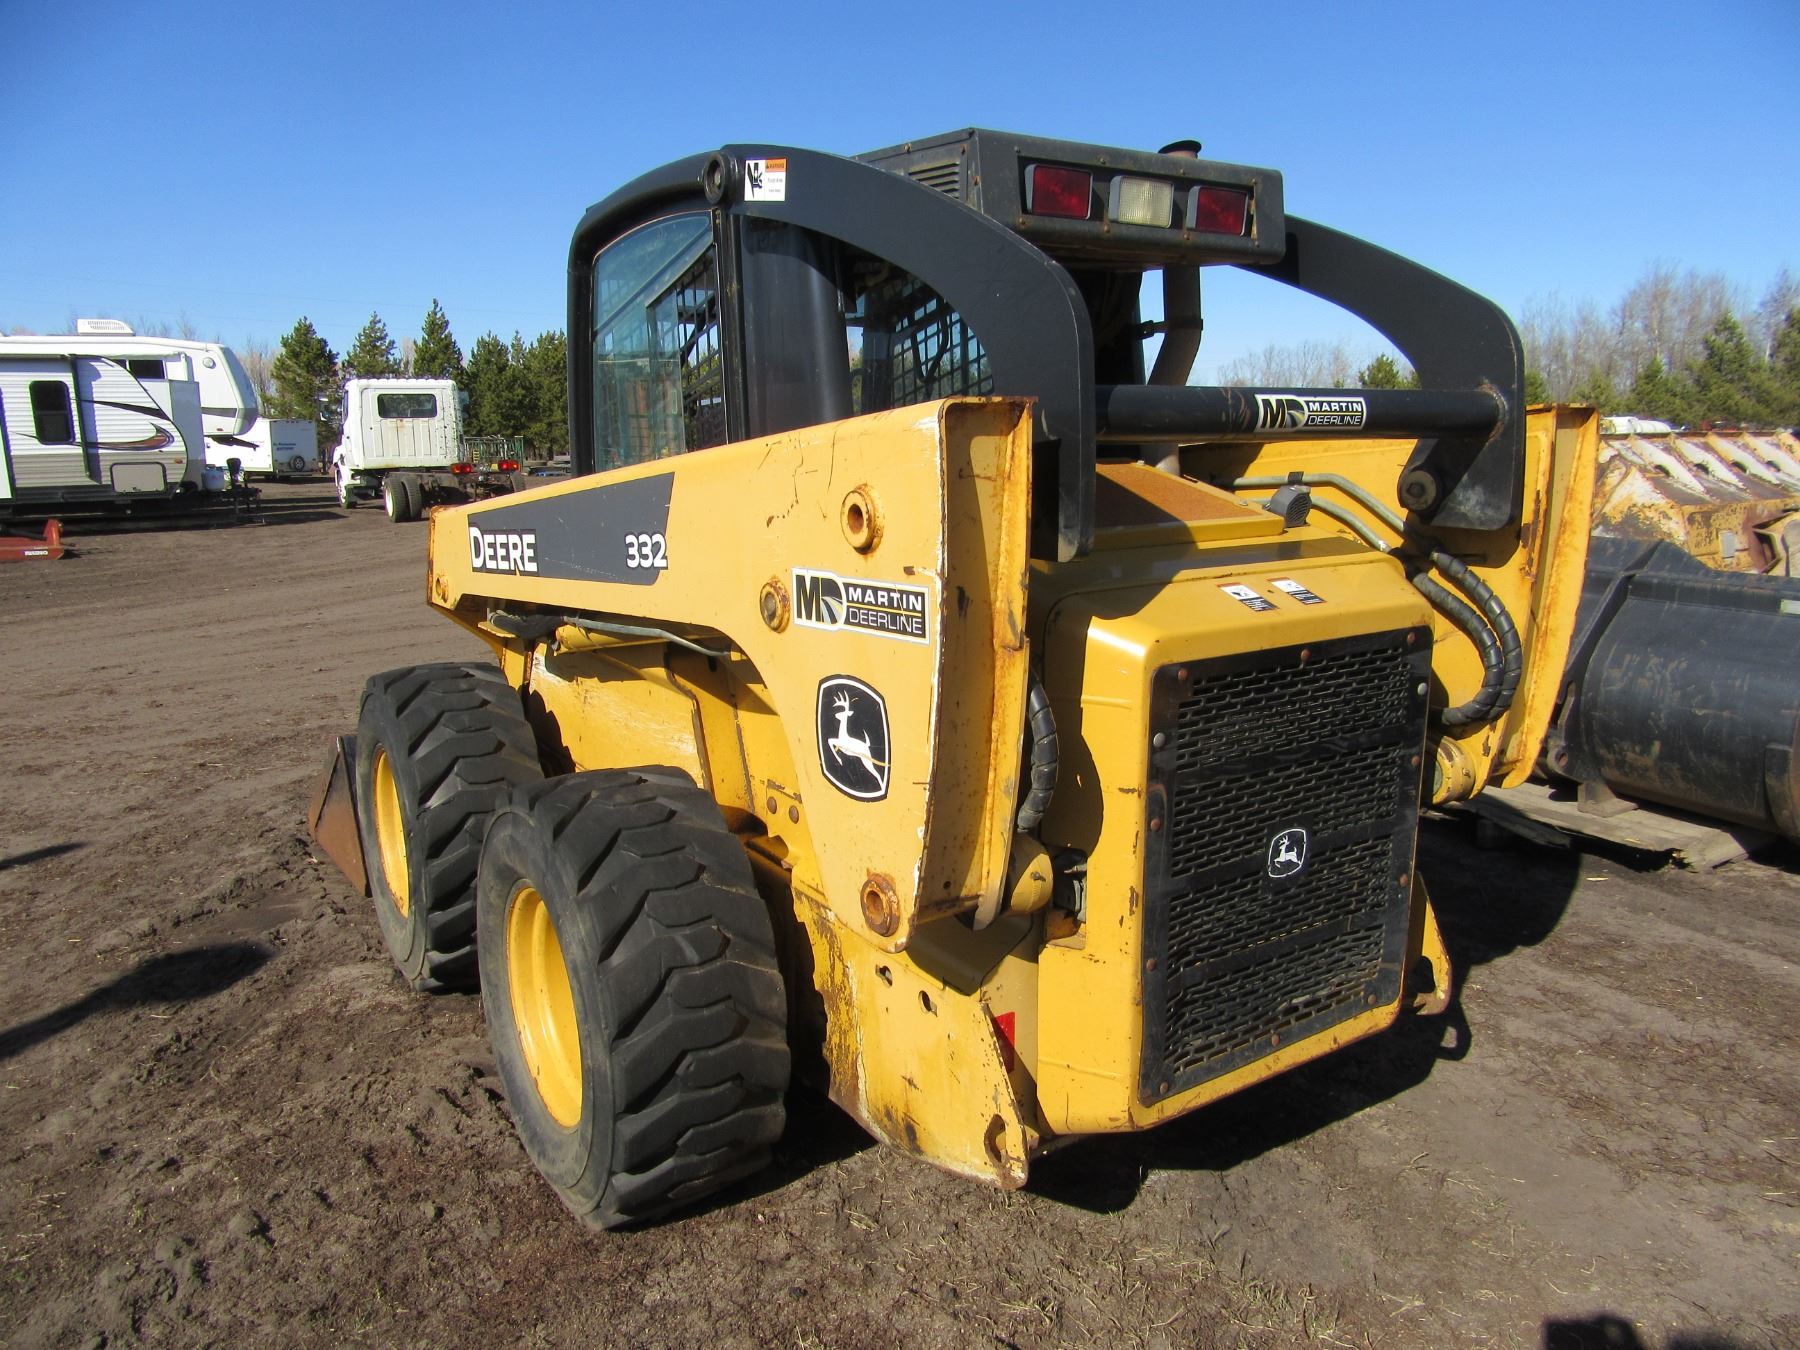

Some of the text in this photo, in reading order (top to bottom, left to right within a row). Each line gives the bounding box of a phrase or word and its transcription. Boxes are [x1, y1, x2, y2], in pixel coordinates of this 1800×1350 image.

[1308, 402, 1362, 412] MARTIN
[1308, 415, 1361, 425] DEERLINE
[469, 526, 538, 572] DEERE
[625, 533, 667, 568] 332
[849, 587, 921, 611] MARTIN
[849, 608, 922, 634] DEERLINE
